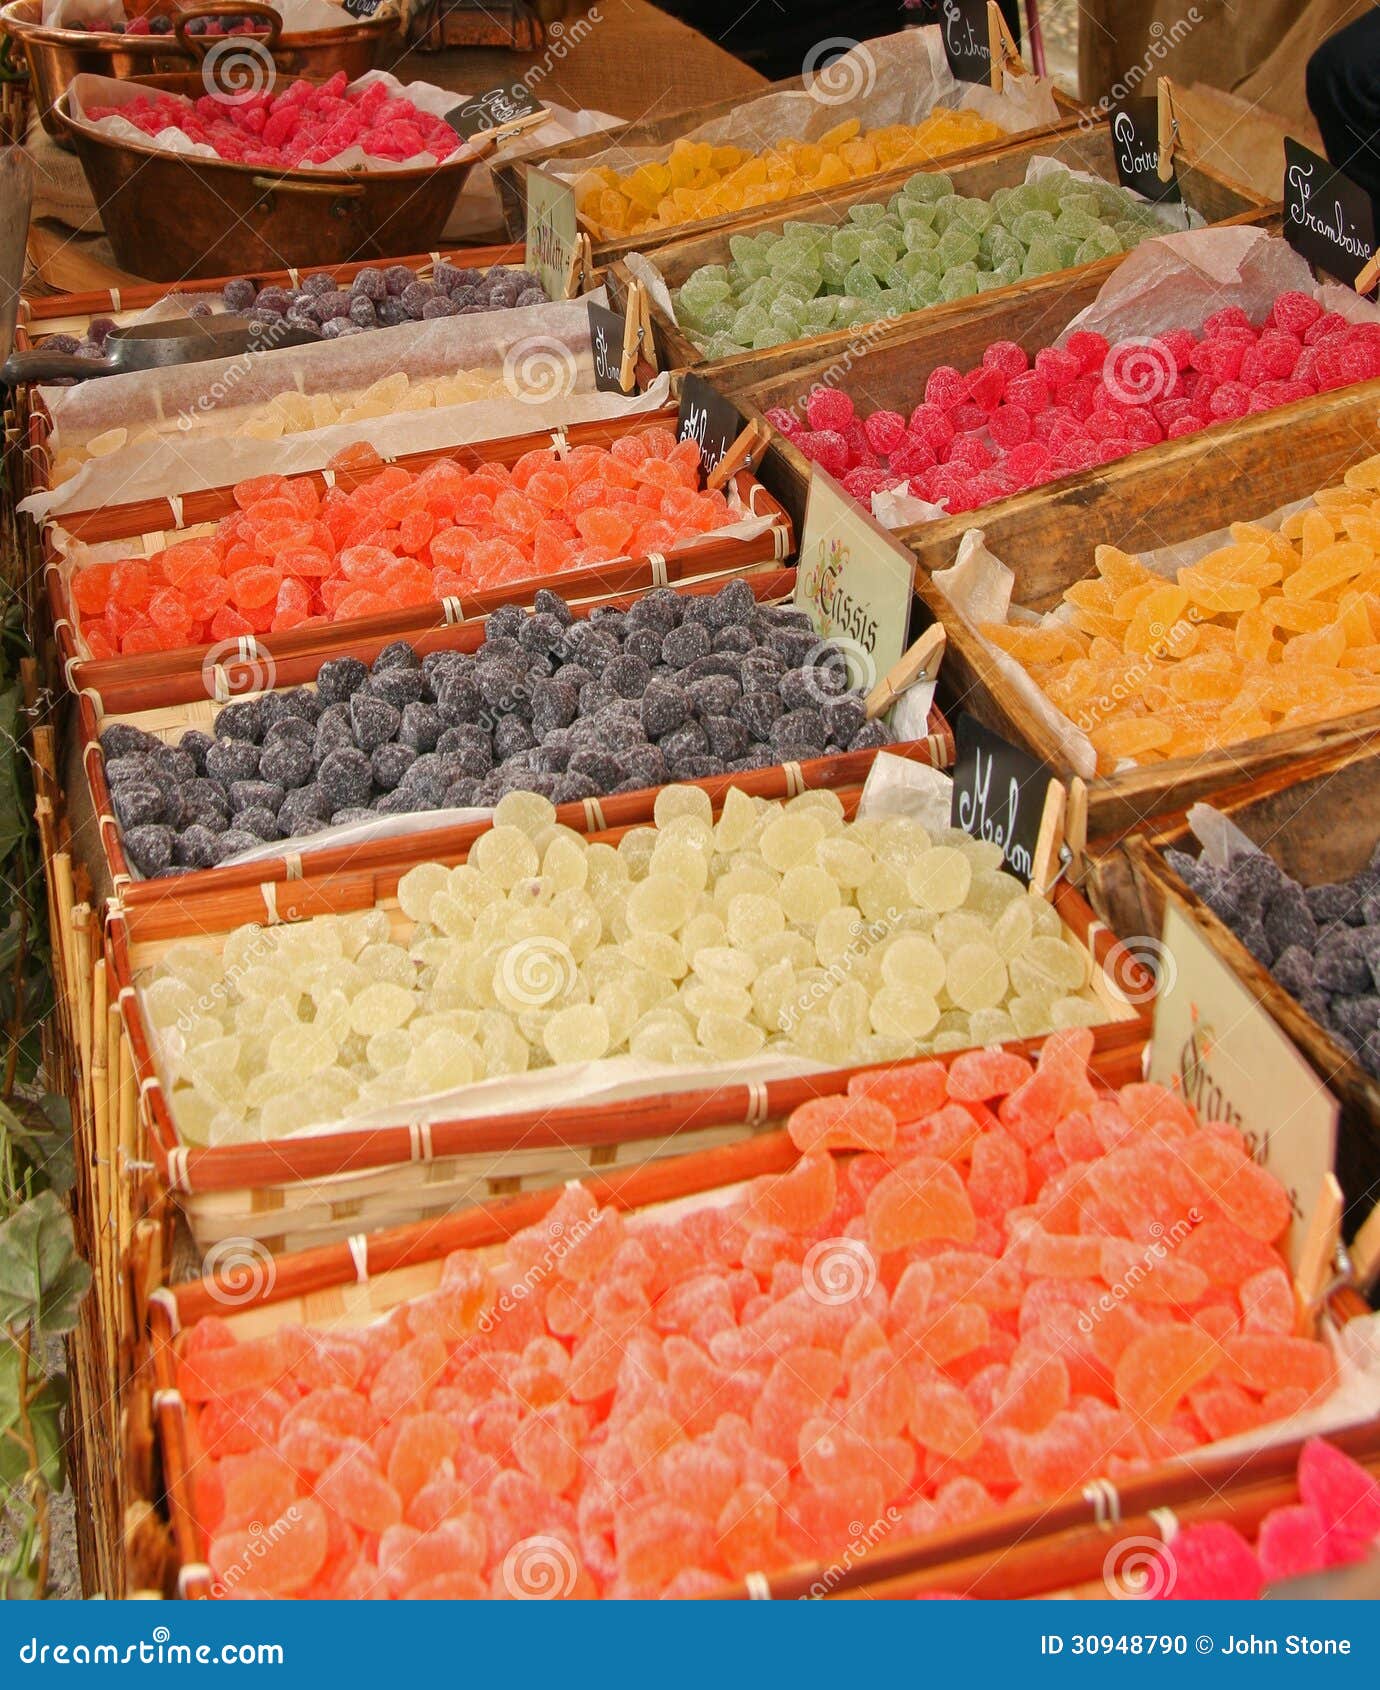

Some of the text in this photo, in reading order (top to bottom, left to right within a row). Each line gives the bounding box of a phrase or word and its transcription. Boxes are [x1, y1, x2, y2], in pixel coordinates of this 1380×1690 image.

[943, 0, 991, 58] Citron
[1114, 111, 1159, 174] Poire
[1289, 163, 1371, 260] Framboise
[820, 565, 879, 655] Cassis
[959, 747, 1034, 880] Melon
